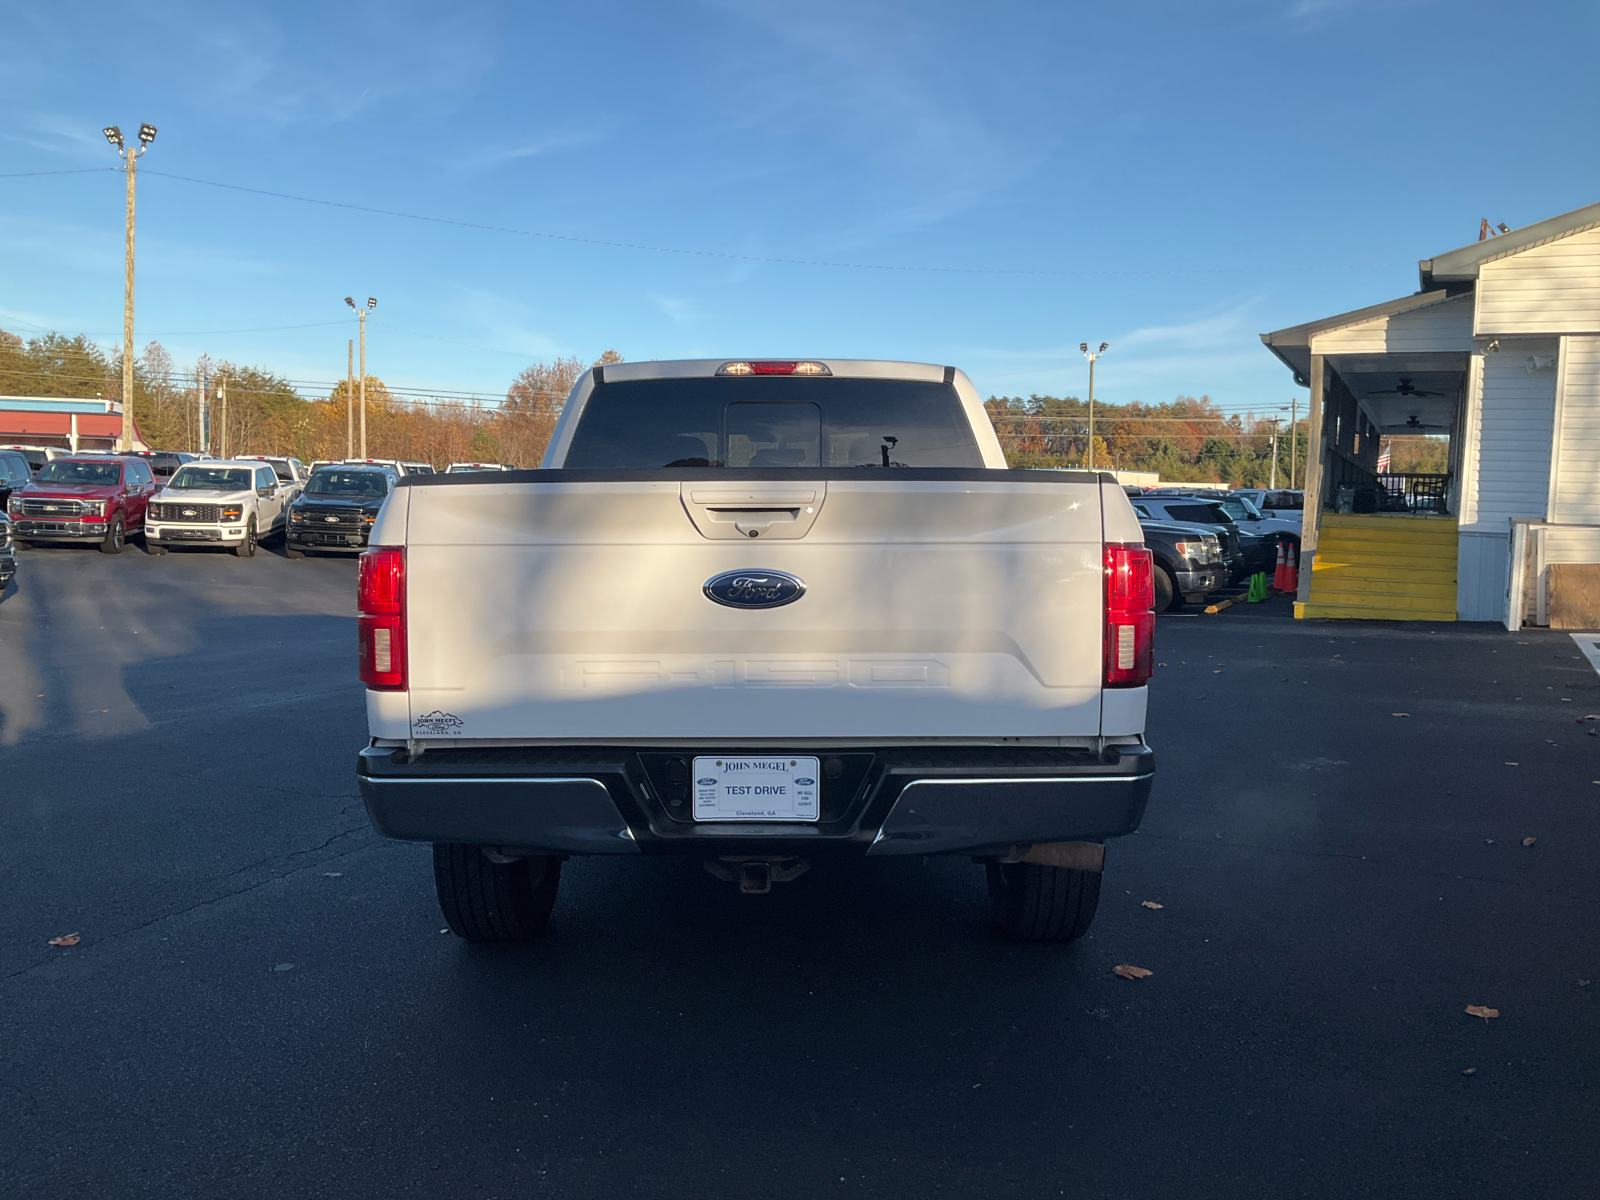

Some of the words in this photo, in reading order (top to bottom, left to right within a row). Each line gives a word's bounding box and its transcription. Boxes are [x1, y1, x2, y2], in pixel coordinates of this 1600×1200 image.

[728, 577, 782, 599] Ford
[560, 659, 951, 689] F-150
[723, 762, 750, 773] JOHN
[753, 762, 789, 772] MEGEL
[725, 786, 752, 795] TEST
[754, 786, 786, 795] DRIVE
